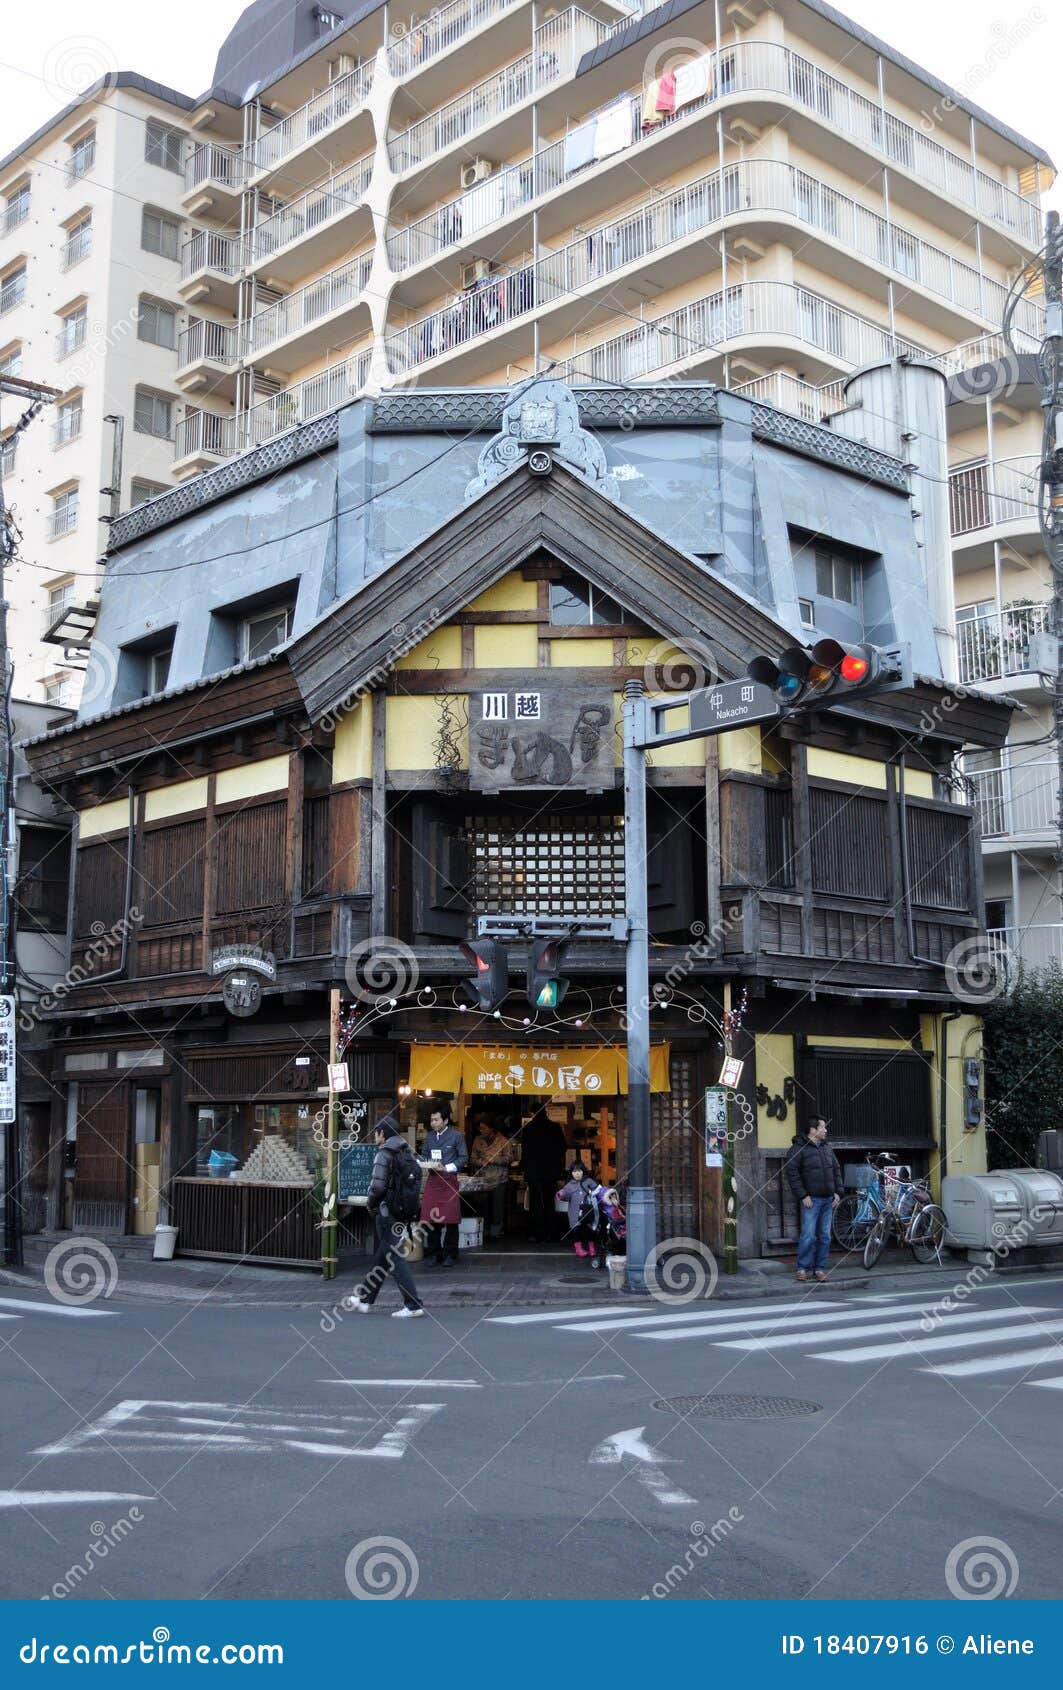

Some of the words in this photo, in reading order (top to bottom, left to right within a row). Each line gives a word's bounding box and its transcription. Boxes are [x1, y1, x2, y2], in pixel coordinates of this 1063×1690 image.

[485, 695, 539, 718] 川越
[710, 685, 755, 711] 仲町
[716, 705, 748, 720] Nakacho
